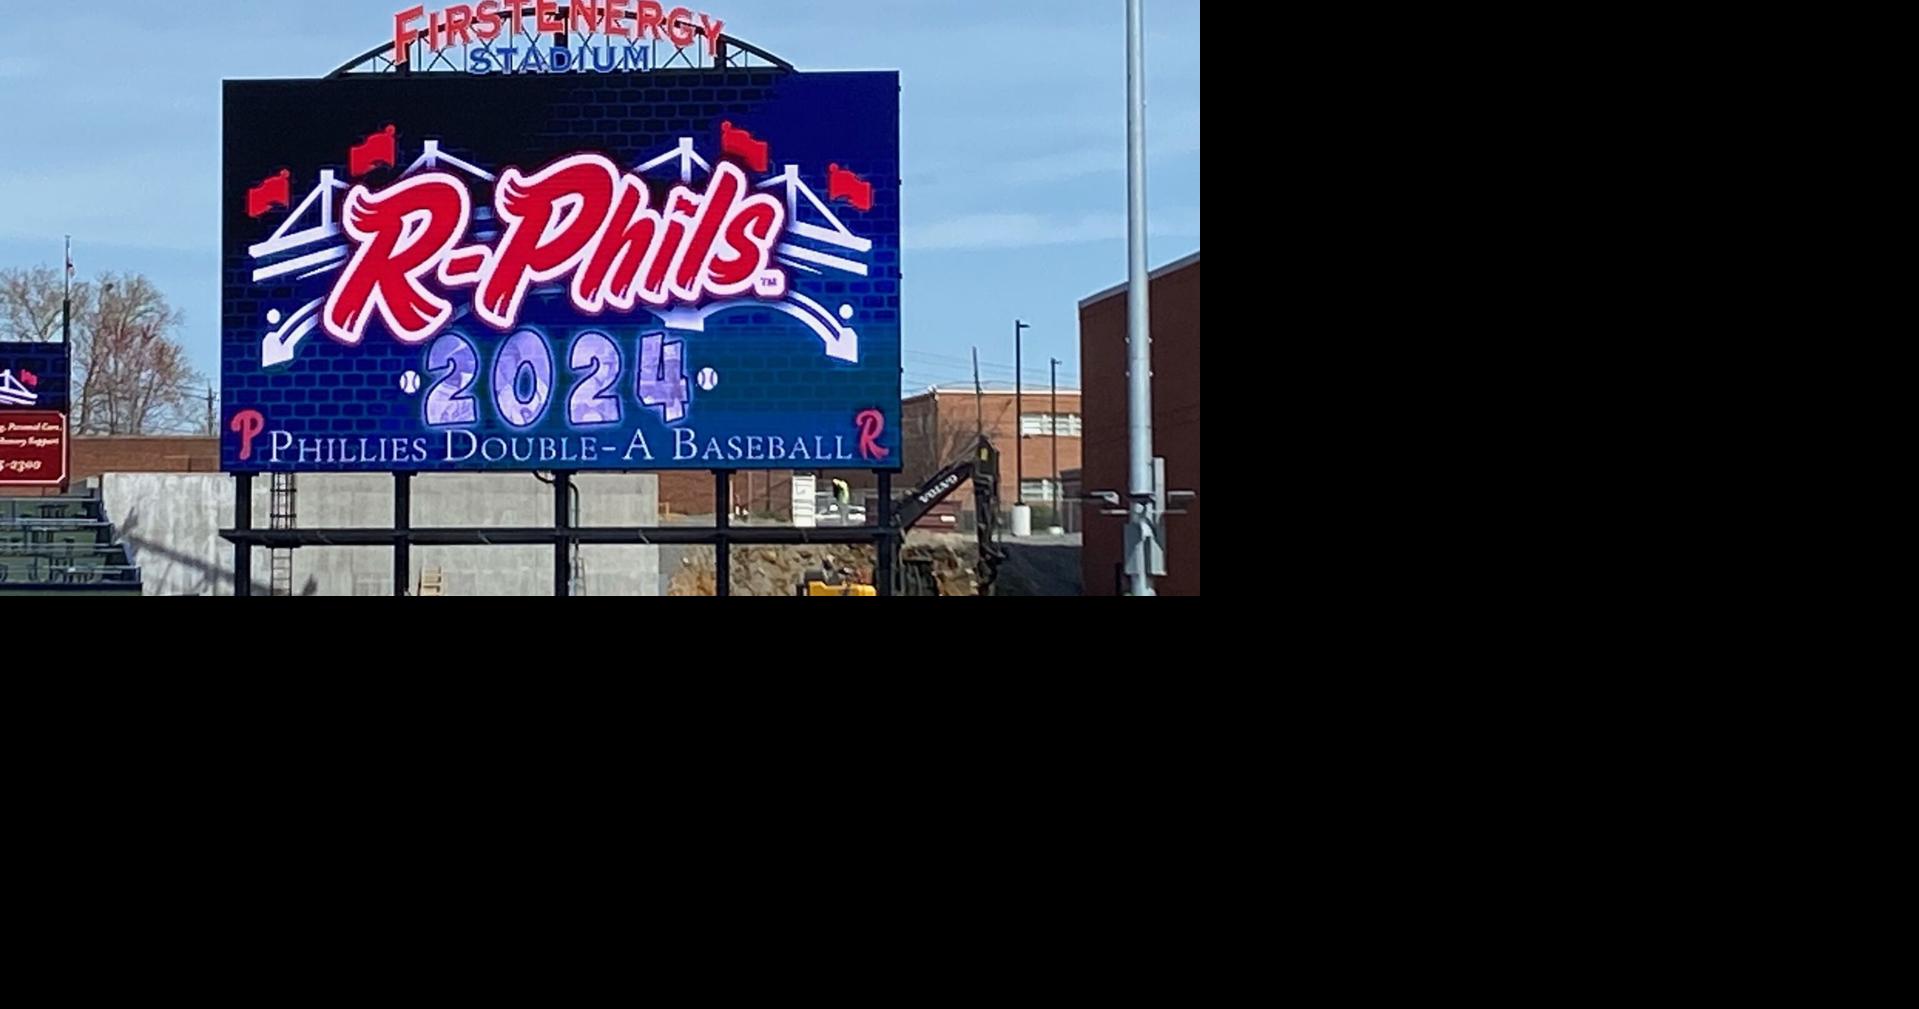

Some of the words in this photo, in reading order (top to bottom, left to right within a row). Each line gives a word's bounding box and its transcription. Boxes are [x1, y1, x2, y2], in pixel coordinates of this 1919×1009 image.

[393, 0, 725, 65] FIRSTENERGY
[468, 45, 651, 75] STADIUM
[323, 153, 784, 344] R-Phils
[424, 330, 692, 427] 2024
[230, 409, 265, 461] P
[269, 430, 427, 463] PHILLIES
[672, 427, 853, 461] BASEBALL
[855, 409, 890, 461] R
[919, 474, 958, 503] VOLVO
